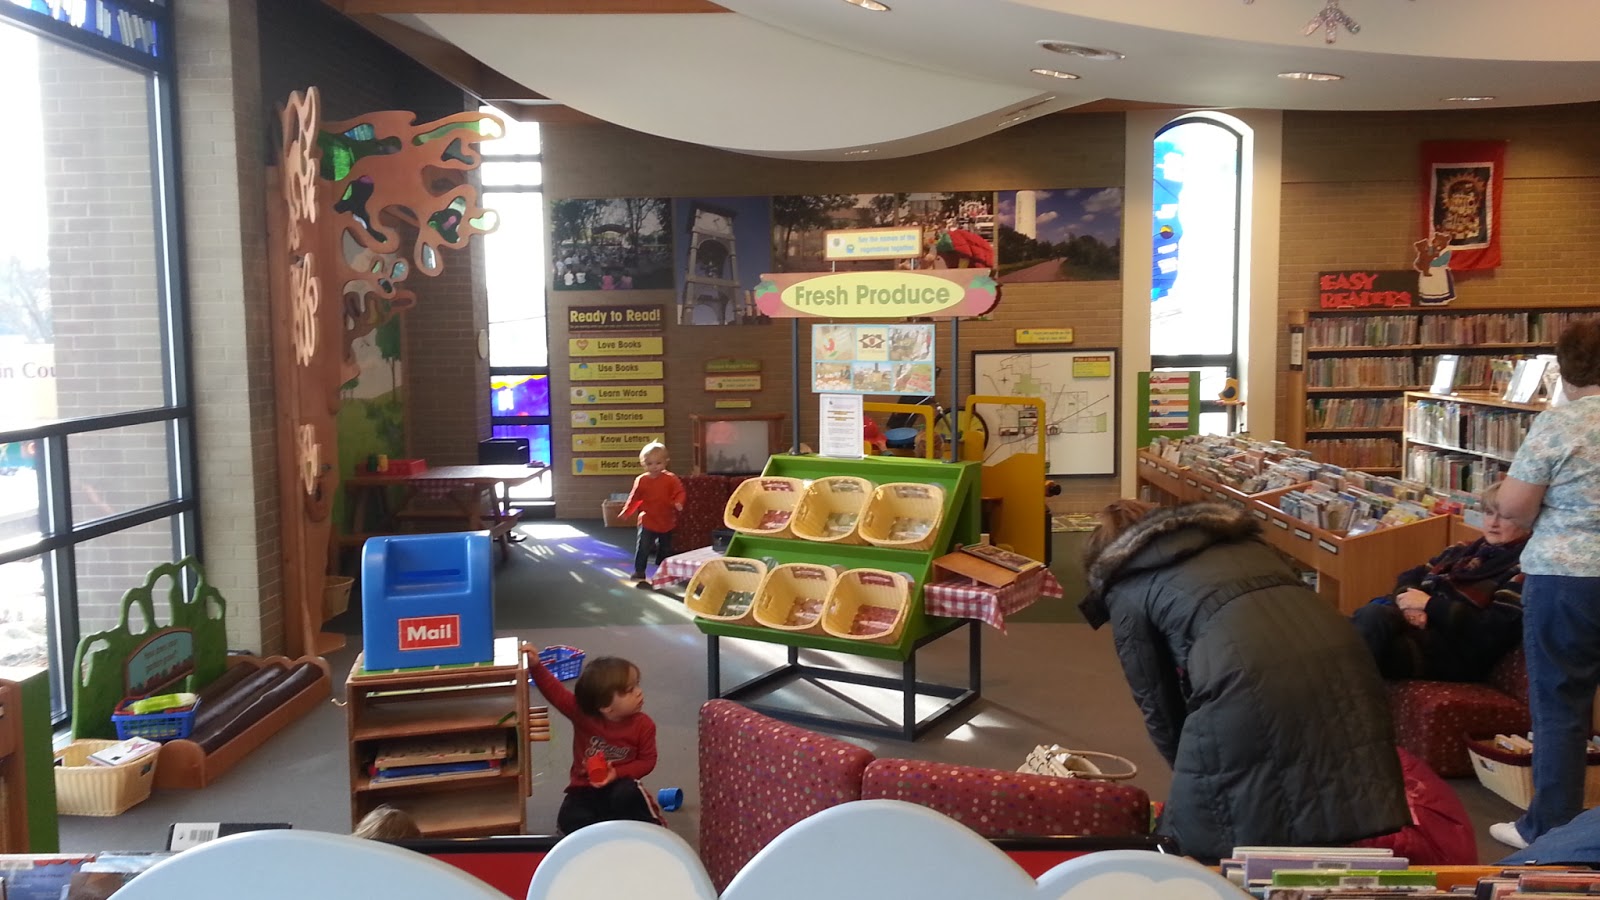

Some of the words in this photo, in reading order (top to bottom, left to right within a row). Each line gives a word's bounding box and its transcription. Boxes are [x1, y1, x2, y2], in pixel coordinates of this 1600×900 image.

[1320, 272, 1379, 291] EASY
[795, 285, 848, 305] Fresh
[856, 284, 950, 305] Produce
[1320, 291, 1411, 309] READERS
[570, 310, 607, 324] Ready
[610, 310, 623, 322] to
[626, 309, 661, 322] Read!
[597, 340, 616, 349] Love
[618, 339, 642, 349] Books
[598, 364, 613, 372] Use
[615, 363, 639, 372] Books
[598, 389, 621, 398] Learn
[623, 388, 648, 398] Words
[600, 412, 613, 421] Tell
[615, 412, 643, 421] Stories
[600, 436, 621, 444] Know
[624, 434, 650, 443] Letters
[601, 460, 620, 468] Hear
[622, 460, 641, 468] Soun
[407, 623, 452, 642] Mail
